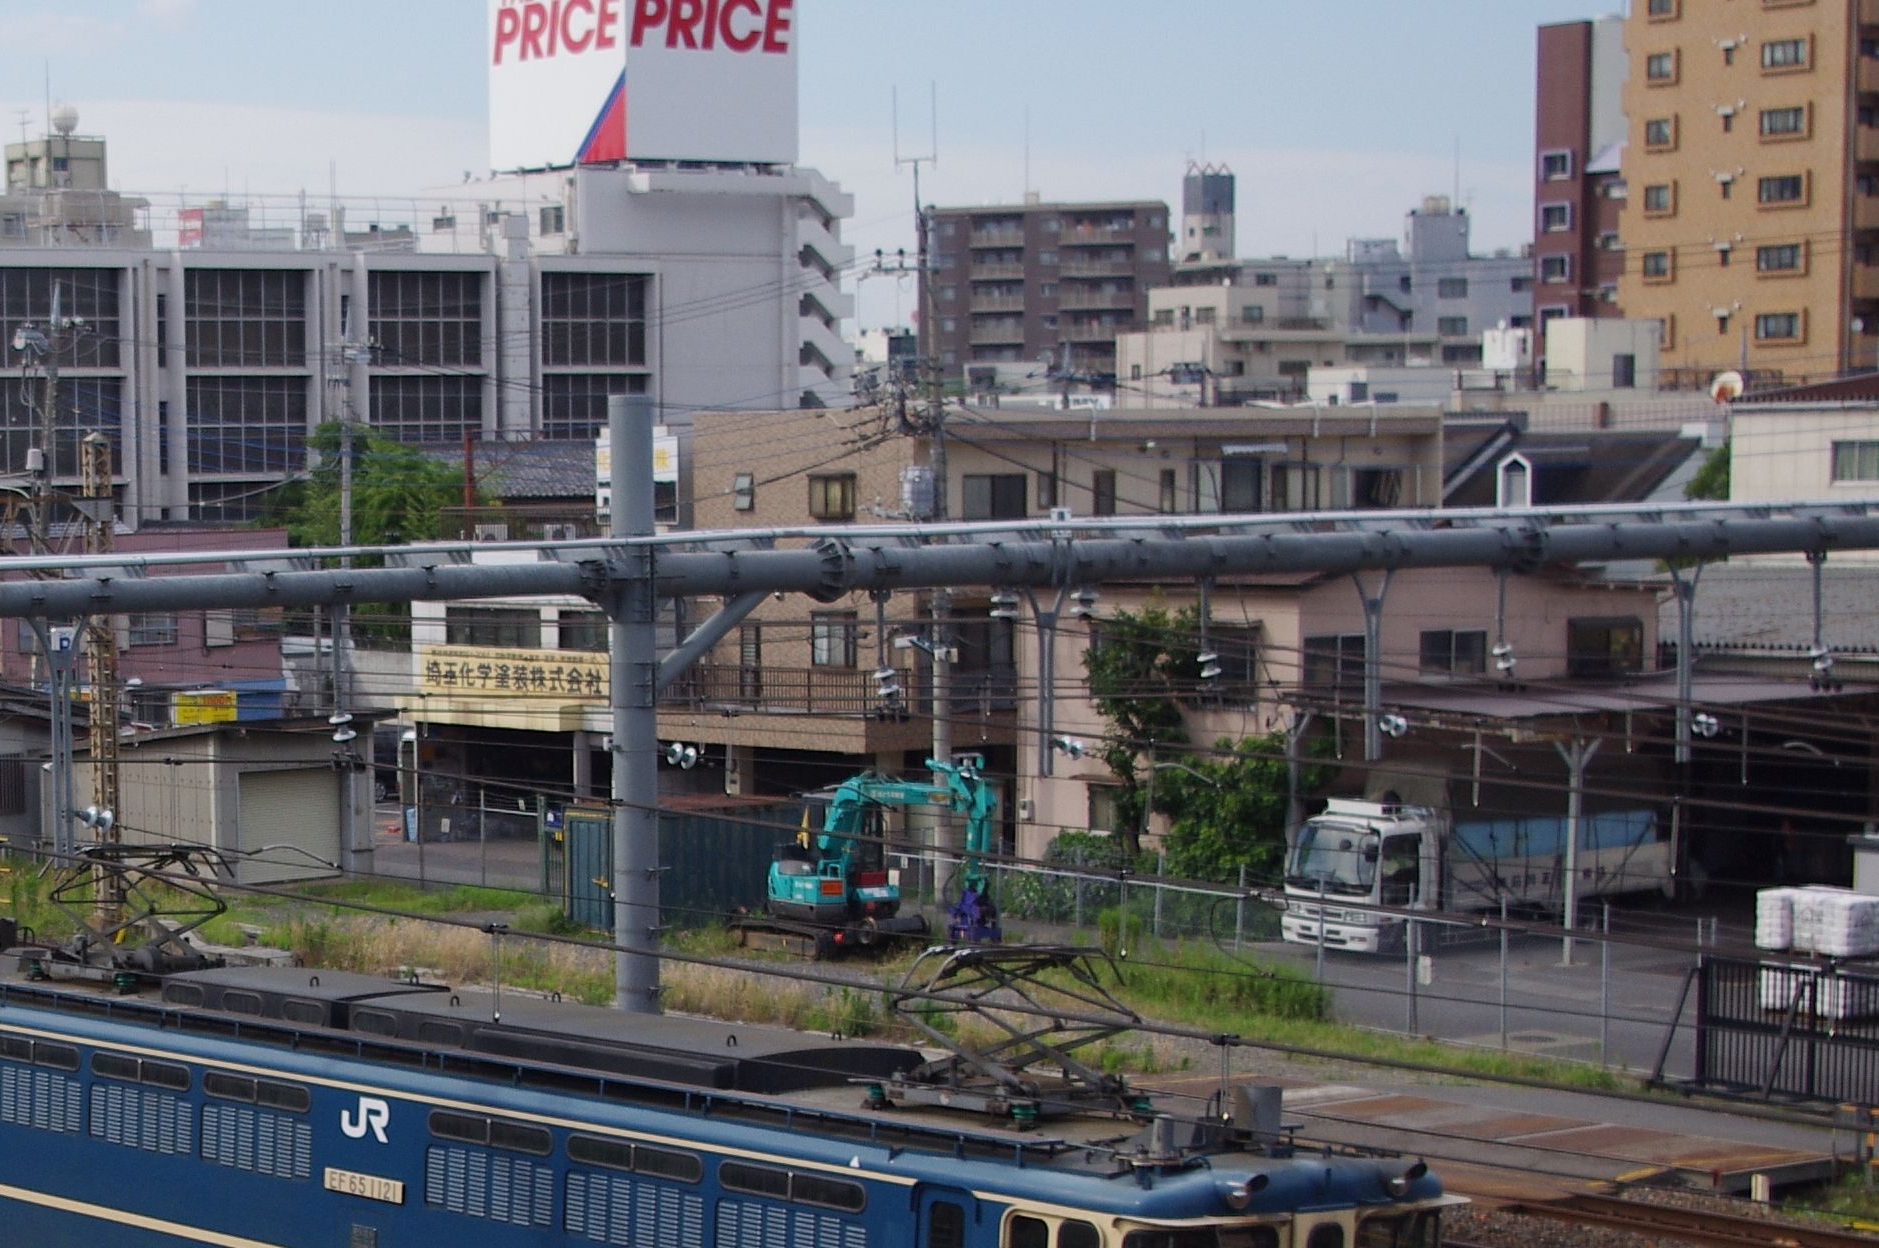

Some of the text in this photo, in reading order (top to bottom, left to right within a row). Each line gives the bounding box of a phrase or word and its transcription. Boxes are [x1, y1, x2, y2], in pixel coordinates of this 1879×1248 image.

[493, 0, 618, 65] PRICE
[630, 0, 794, 54] PRICE
[341, 1096, 390, 1144] JR
[370, 1178, 397, 1201] 1121
